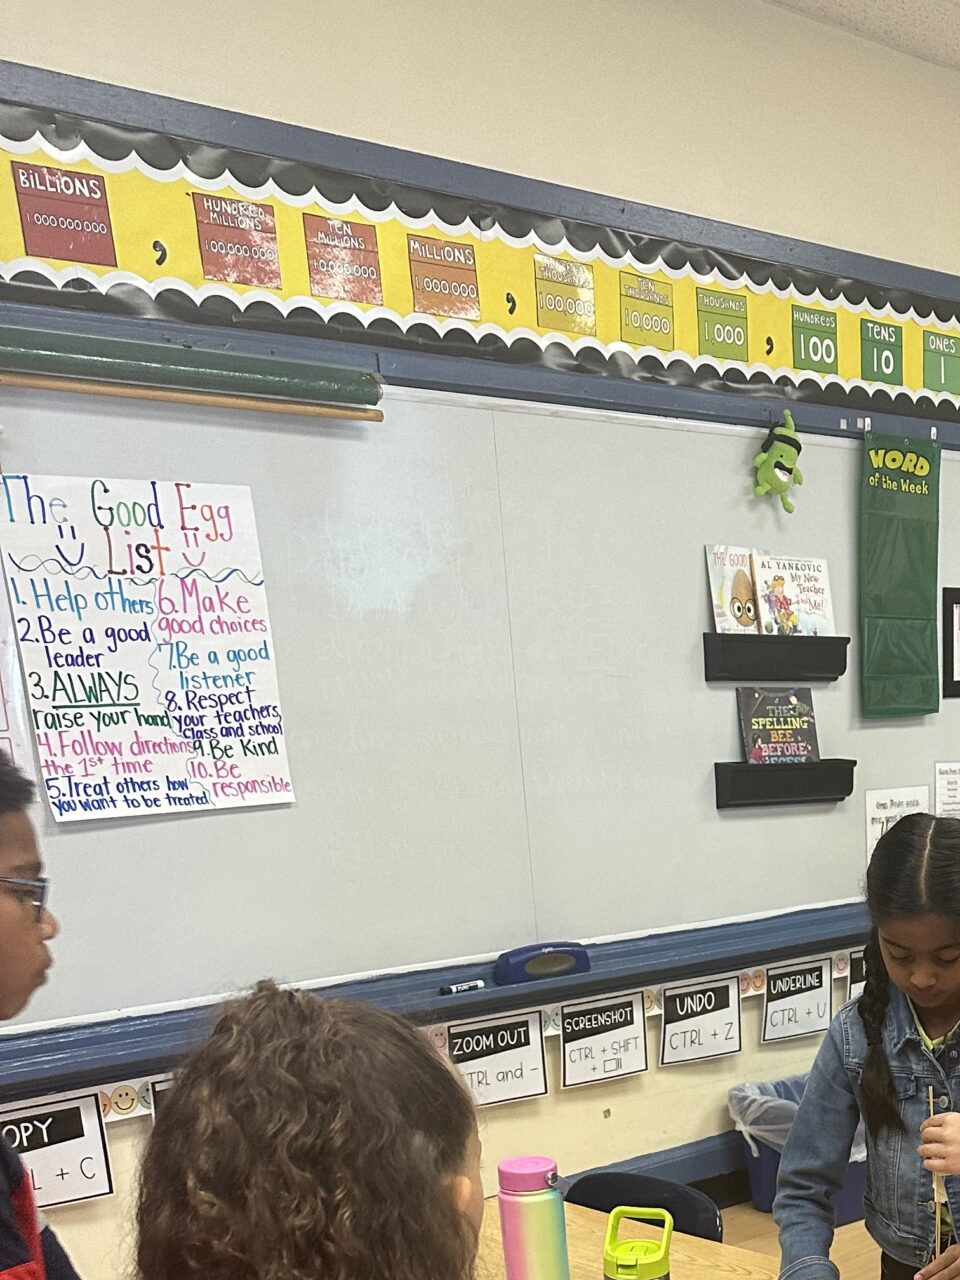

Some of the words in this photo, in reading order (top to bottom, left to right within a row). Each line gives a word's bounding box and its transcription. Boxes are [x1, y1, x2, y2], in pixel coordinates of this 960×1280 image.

[799, 332, 835, 365] 100
[873, 348, 894, 374] 10
[868, 448, 931, 477] WORD
[869, 472, 881, 488] of
[881, 475, 898, 491] the
[900, 478, 930, 495] Week
[3, 474, 68, 526] The
[91, 479, 165, 530] Good
[175, 482, 234, 542] Egg
[103, 526, 172, 577] List
[713, 552, 726, 568] THE
[729, 553, 749, 568] GOOD
[760, 560, 773, 570] AL
[776, 561, 823, 573] YANKOVIC
[790, 572, 801, 583] My
[803, 572, 820, 583] New
[30, 577, 89, 622] Help
[94, 577, 156, 615] others
[797, 582, 825, 596] Teacher
[82, 627, 96, 644] a
[104, 621, 152, 653] good
[157, 615, 205, 645] good
[209, 615, 268, 636] choices
[45, 646, 105, 669] leader
[207, 650, 221, 667] a
[227, 640, 271, 672] good
[51, 670, 140, 703] ALWAYS
[179, 670, 256, 691] listener
[186, 687, 257, 714] Respect
[766, 705, 791, 717] THE
[32, 708, 86, 731] raise
[91, 708, 129, 733] your
[135, 707, 172, 729] hand
[171, 714, 209, 734] your
[220, 722, 245, 738] and
[248, 720, 284, 737] school
[751, 717, 809, 730] SPELLING
[130, 729, 197, 756] directions
[770, 729, 795, 742] BEE
[762, 742, 808, 756] BEFORE
[41, 758, 74, 777] the
[79, 756, 105, 779] 1st
[111, 756, 154, 776] time
[215, 759, 242, 779] Be
[115, 777, 161, 795] others
[166, 775, 189, 792] how
[212, 776, 292, 801] responsible
[52, 799, 77, 817] you
[79, 796, 119, 812] want
[124, 794, 141, 809] to
[142, 793, 162, 808] be
[164, 791, 210, 807] treated
[770, 971, 821, 995] UNDERLINE
[676, 991, 716, 1016] UNDO
[769, 1007, 800, 1028] CTRL
[817, 1001, 827, 1019] U
[564, 1007, 632, 1034] SCREENSHOT
[453, 1029, 494, 1055] ZOOM
[498, 1026, 528, 1048] OUT
[669, 1031, 703, 1051] CTRL
[724, 1021, 735, 1041] Z
[569, 1045, 596, 1065] CTRL
[610, 1035, 639, 1056] SHIFT
[462, 1069, 495, 1089] TRL
[496, 1066, 524, 1084] and
[80, 1156, 96, 1179] C
